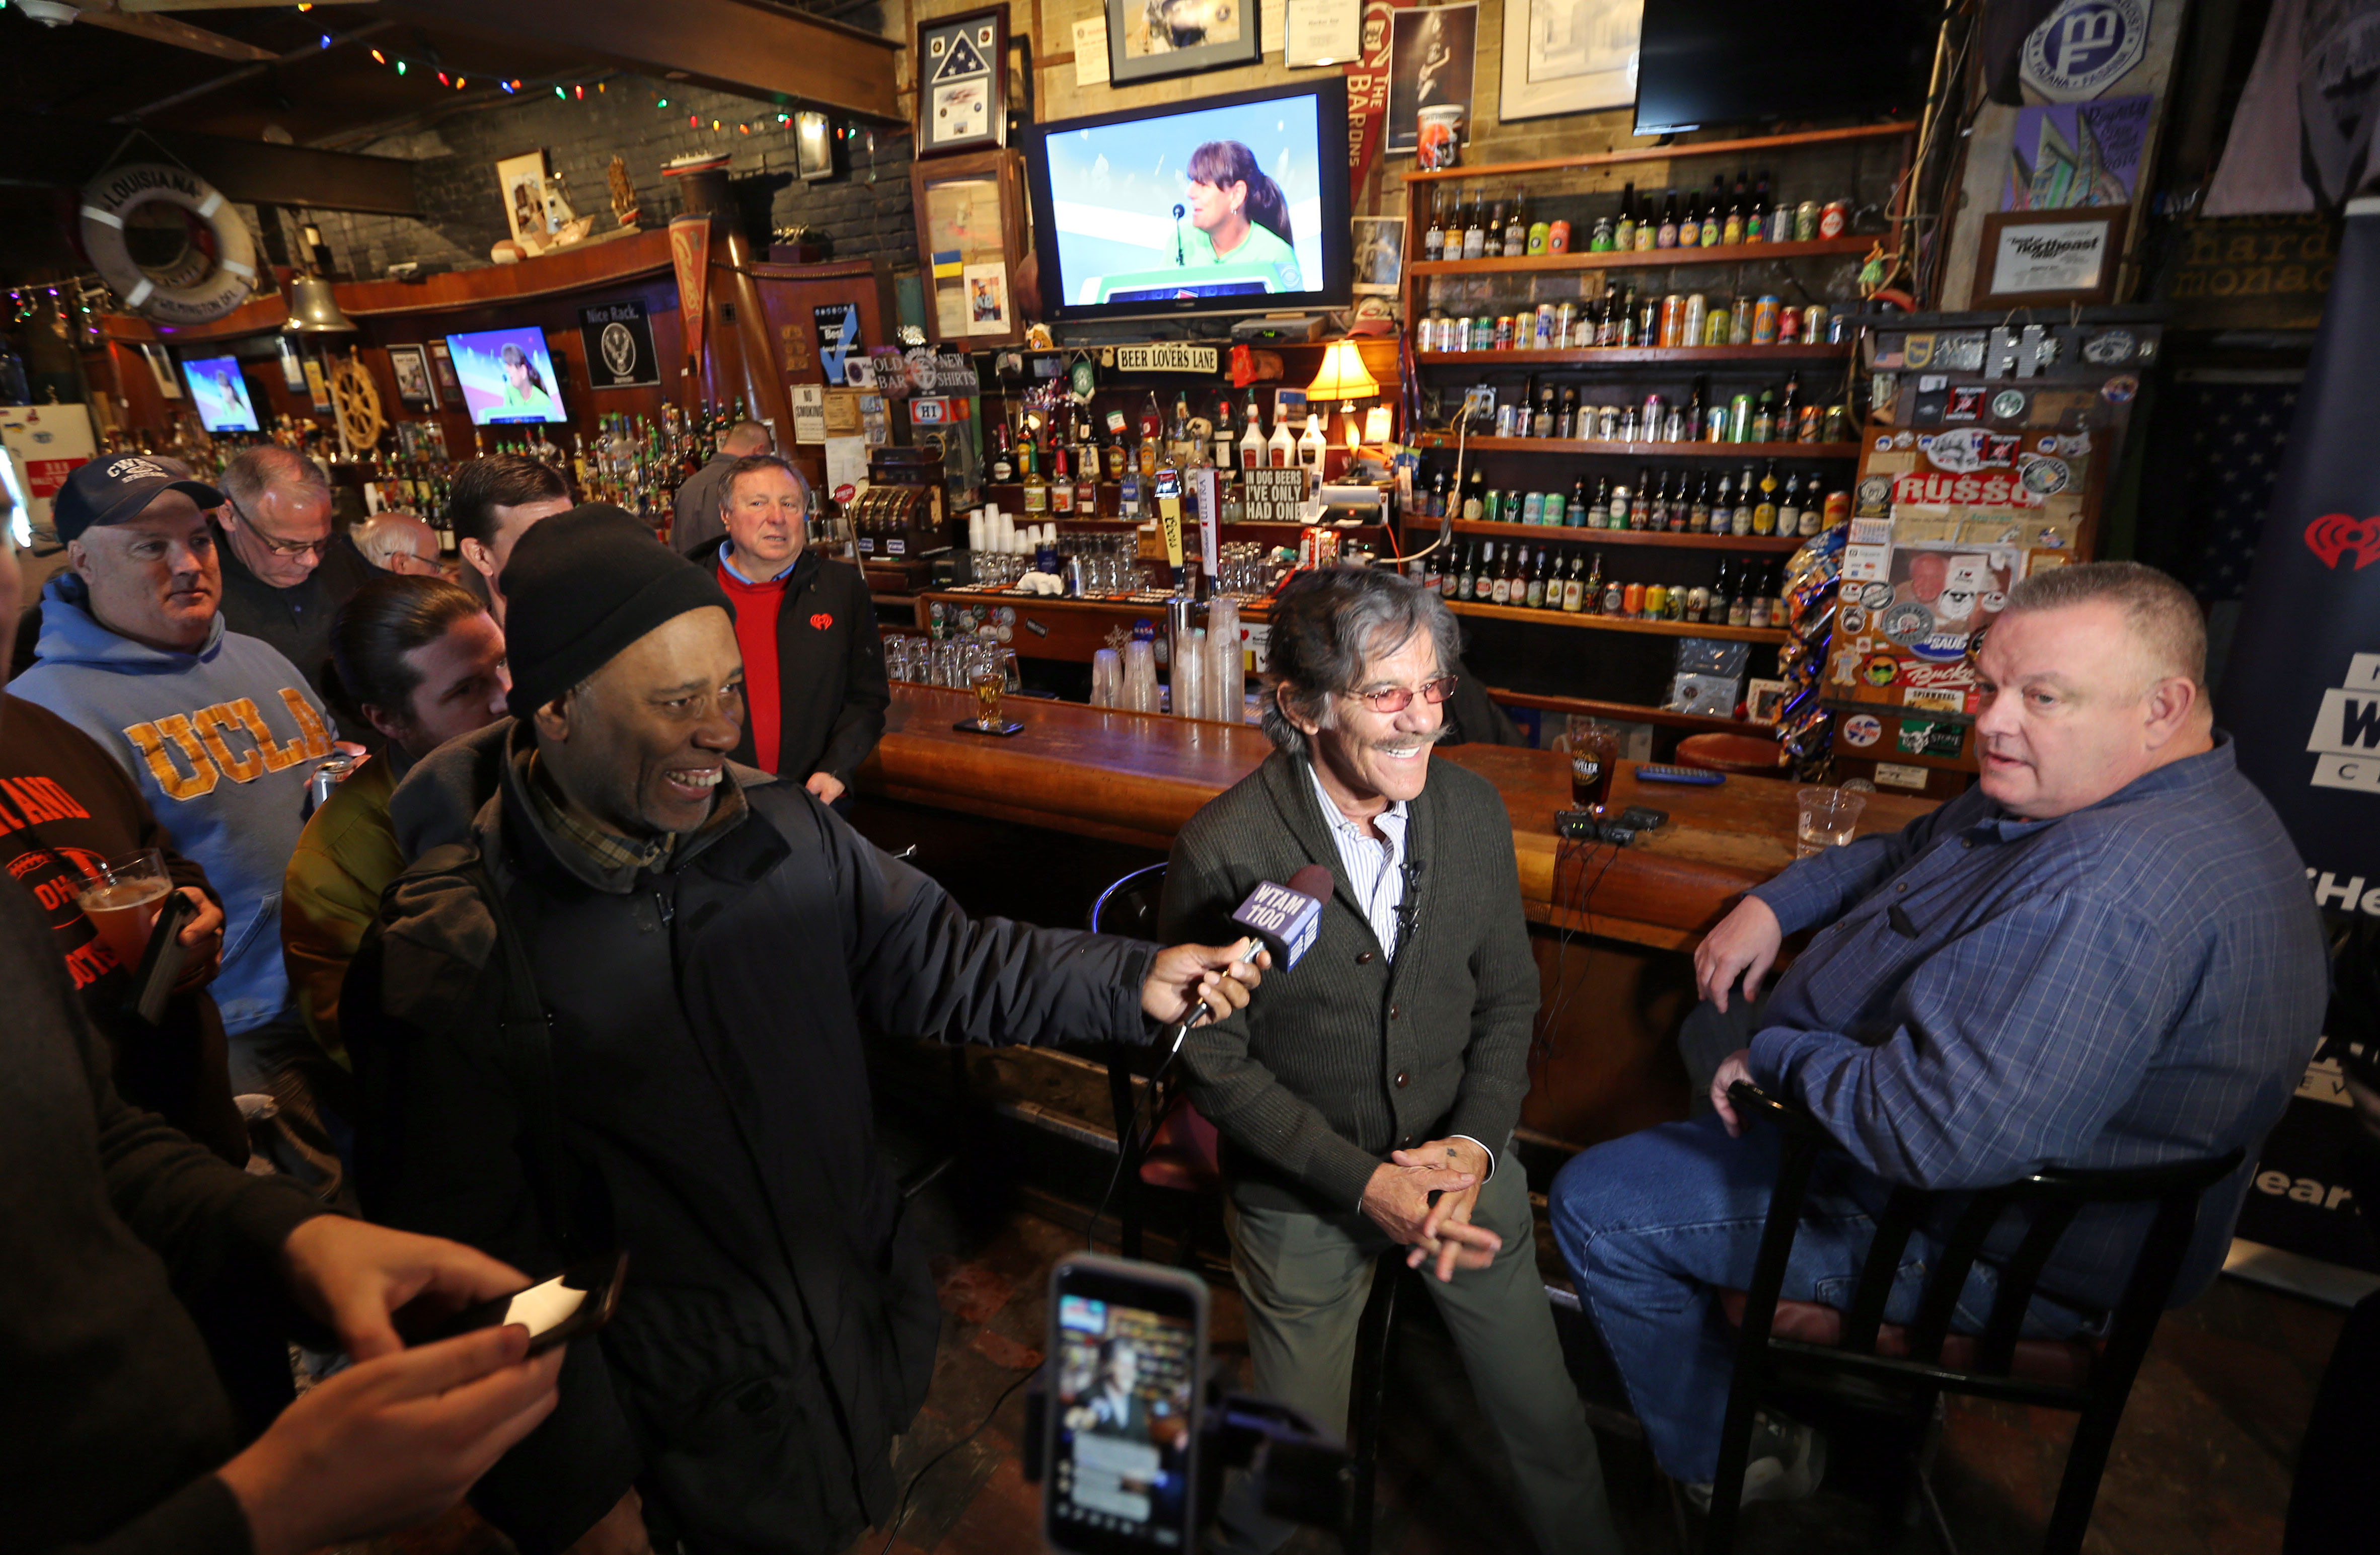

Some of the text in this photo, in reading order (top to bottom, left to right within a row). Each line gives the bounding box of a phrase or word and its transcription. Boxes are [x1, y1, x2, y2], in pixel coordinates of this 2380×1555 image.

[1369, 75, 1389, 108] THE
[1347, 74, 1372, 167] BARONS
[103, 171, 201, 208] LOUISIANA
[586, 308, 609, 324] Nice
[873, 357, 903, 372] OLD
[938, 353, 964, 368] NEW
[1121, 349, 1215, 368] BEER LOVERS LANE
[878, 374, 908, 389] BAR
[936, 370, 976, 387] SHIRTS
[803, 389, 812, 402] NO
[795, 405, 824, 417] SMOKING
[922, 406, 937, 417] HI
[1246, 470, 1302, 485] IN DOG BEERS
[1199, 479, 1208, 519] ULTRA
[1246, 485, 1302, 502] I'VE ONLY
[1246, 501, 1300, 521] HAD ONE
[1134, 627, 1154, 635] NASA
[122, 687, 334, 802] UCLA
[0, 776, 91, 837] LAND
[1253, 883, 1306, 916] WTAM
[1246, 904, 1286, 931] 1100
[2252, 1167, 2356, 1211] ear
